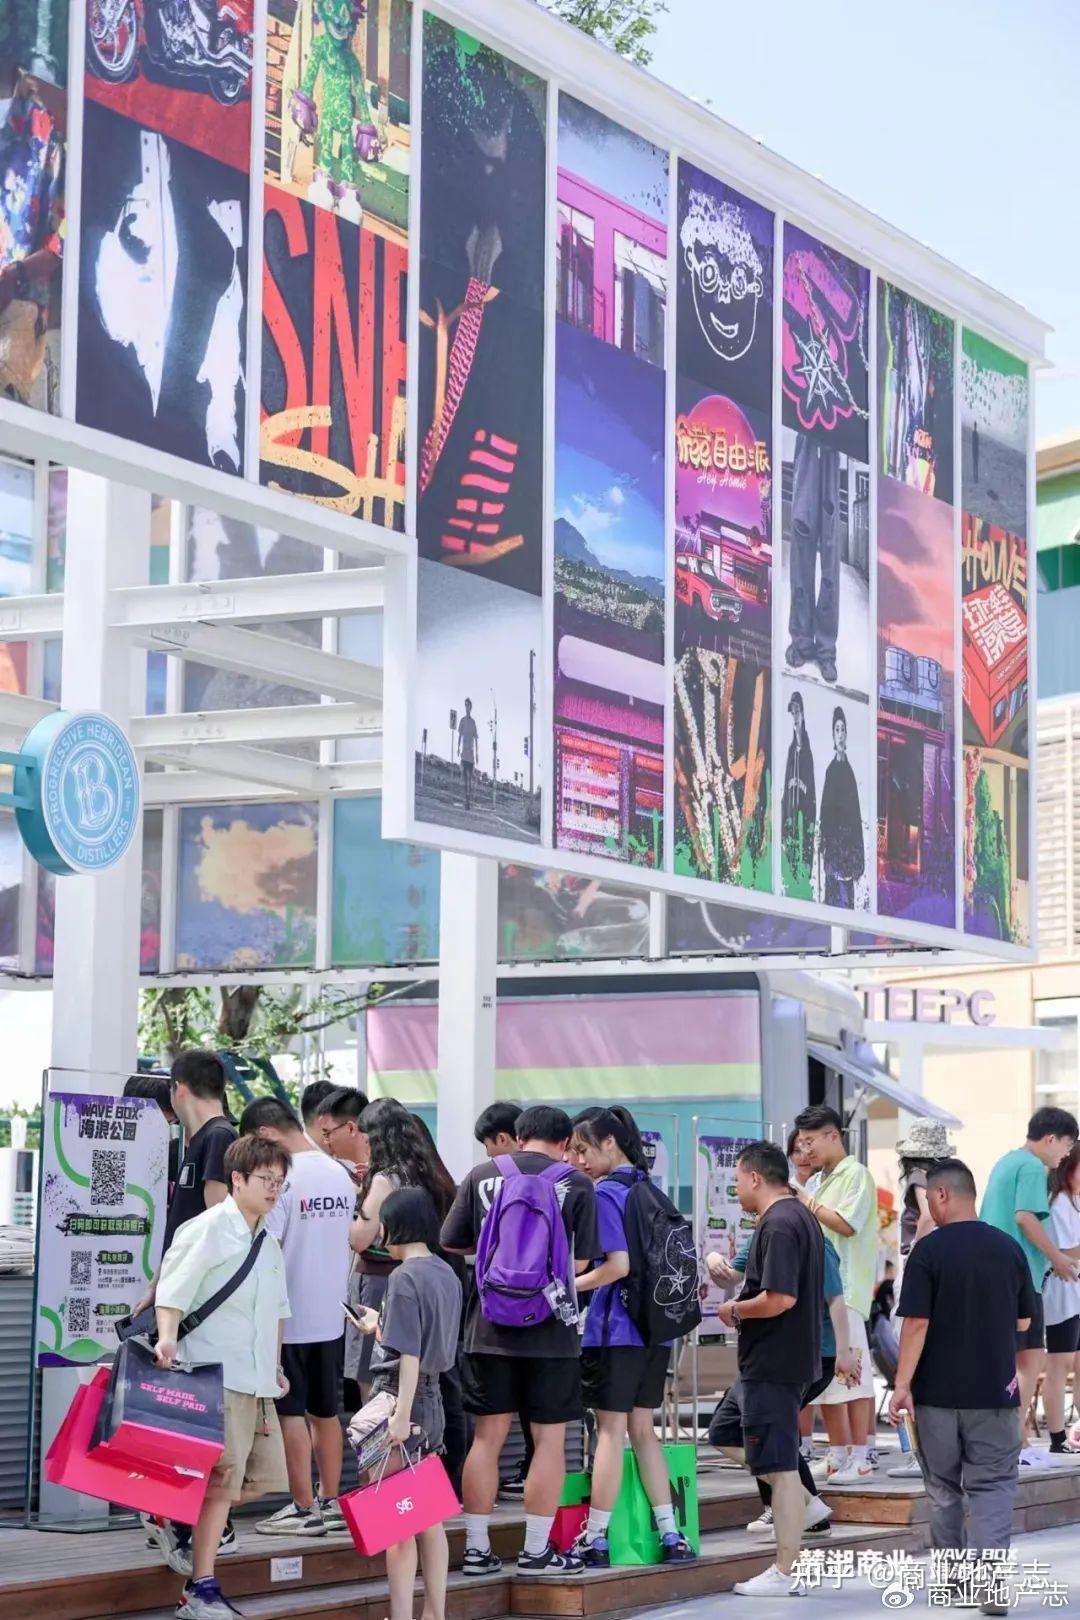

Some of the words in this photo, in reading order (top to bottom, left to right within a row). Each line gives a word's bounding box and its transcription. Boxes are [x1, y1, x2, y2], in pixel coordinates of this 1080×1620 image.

[48, 724, 86, 826] PROGRESSIVE
[86, 723, 133, 790] HEBRIDEAN
[77, 819, 130, 863] DISTILLERS
[79, 1119, 137, 1141] 海浪公园
[300, 1196, 350, 1212] MEDAL
[139, 1383, 166, 1395] SELF
[156, 1395, 182, 1406] SELF
